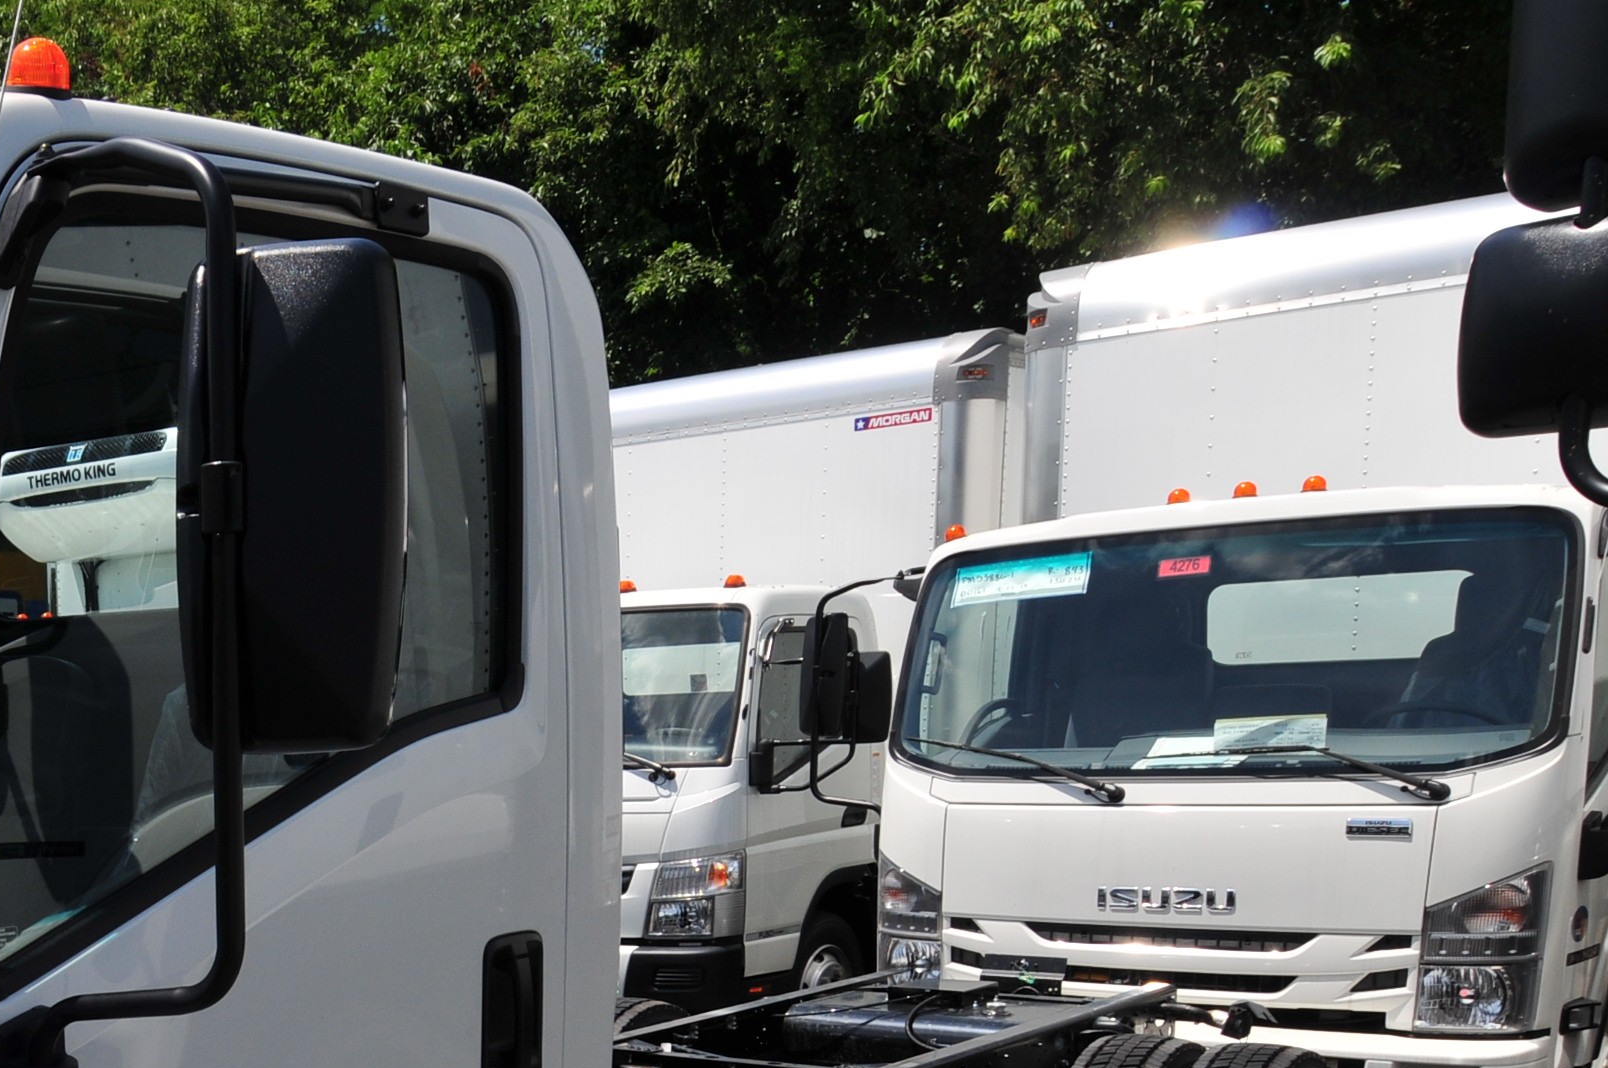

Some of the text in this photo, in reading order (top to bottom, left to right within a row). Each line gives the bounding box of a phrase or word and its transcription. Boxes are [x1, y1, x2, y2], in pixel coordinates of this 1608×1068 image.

[867, 410, 931, 429] MORGAN
[27, 462, 117, 489] THERMO KING
[1169, 558, 1201, 573] 4276
[1097, 886, 1236, 912] ISUZU
